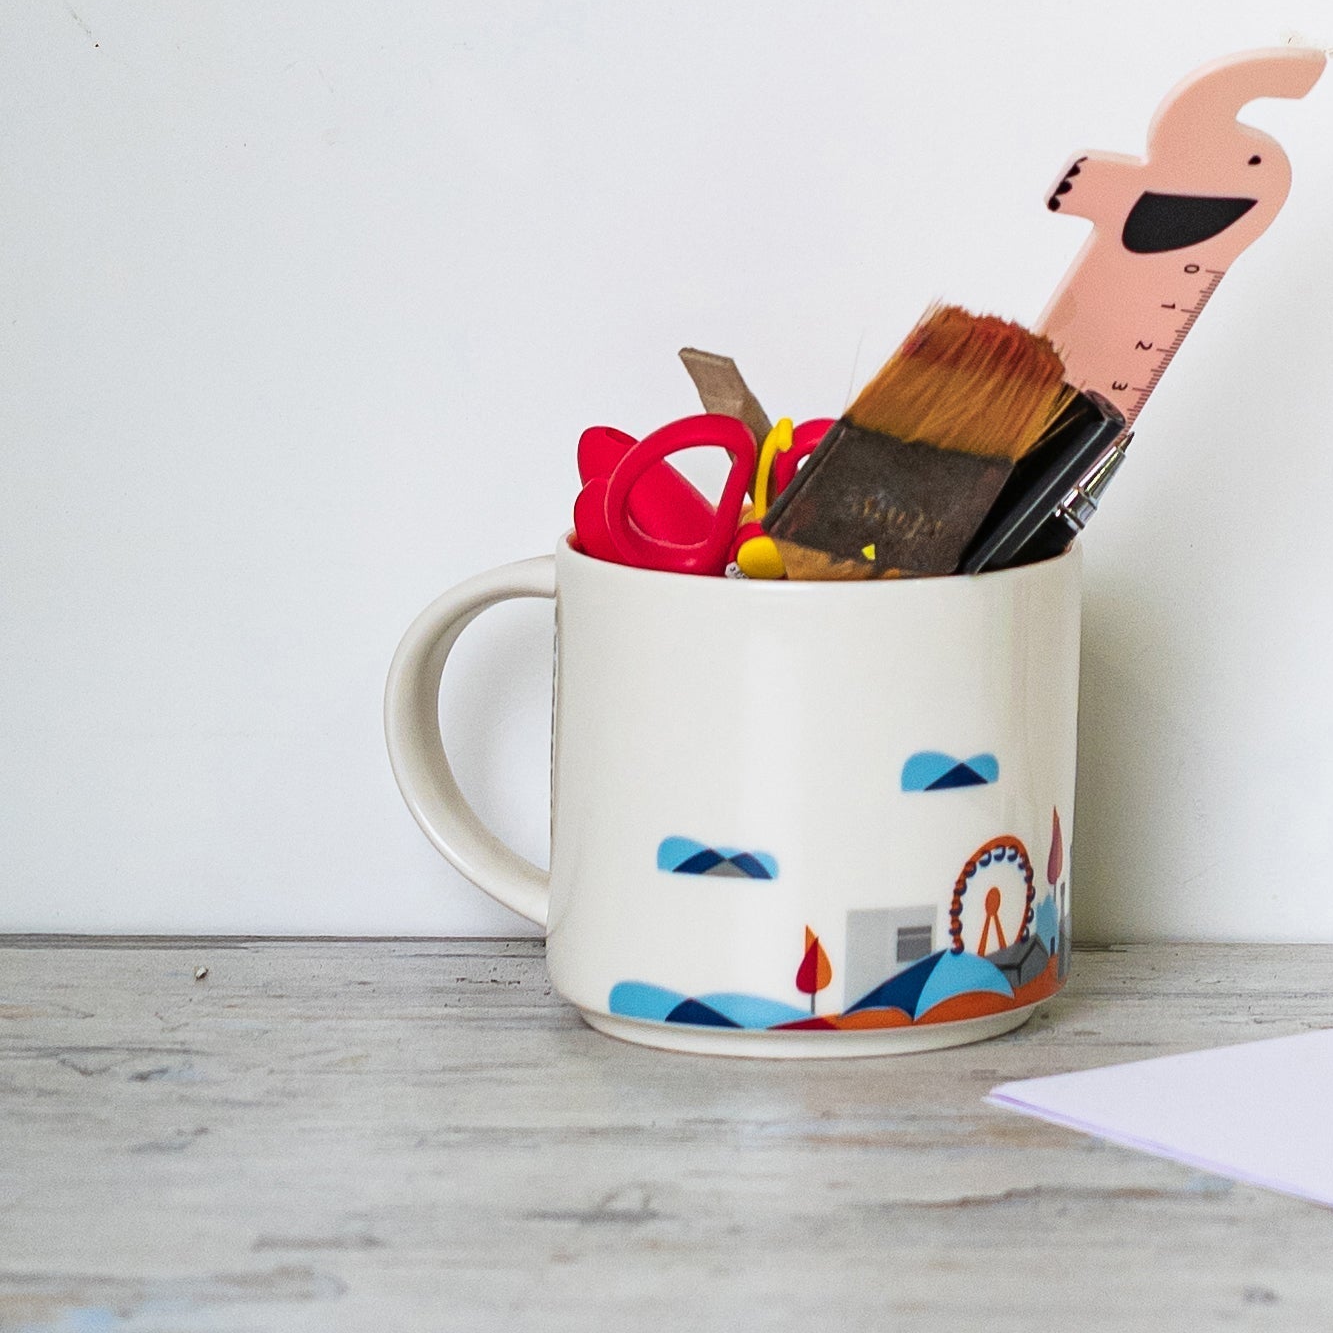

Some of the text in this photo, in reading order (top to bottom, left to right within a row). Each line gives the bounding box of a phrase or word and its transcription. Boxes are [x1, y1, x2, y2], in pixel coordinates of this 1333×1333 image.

[1184, 264, 1200, 274] 0
[1135, 340, 1153, 351] 2
[1112, 381, 1128, 391] 3
